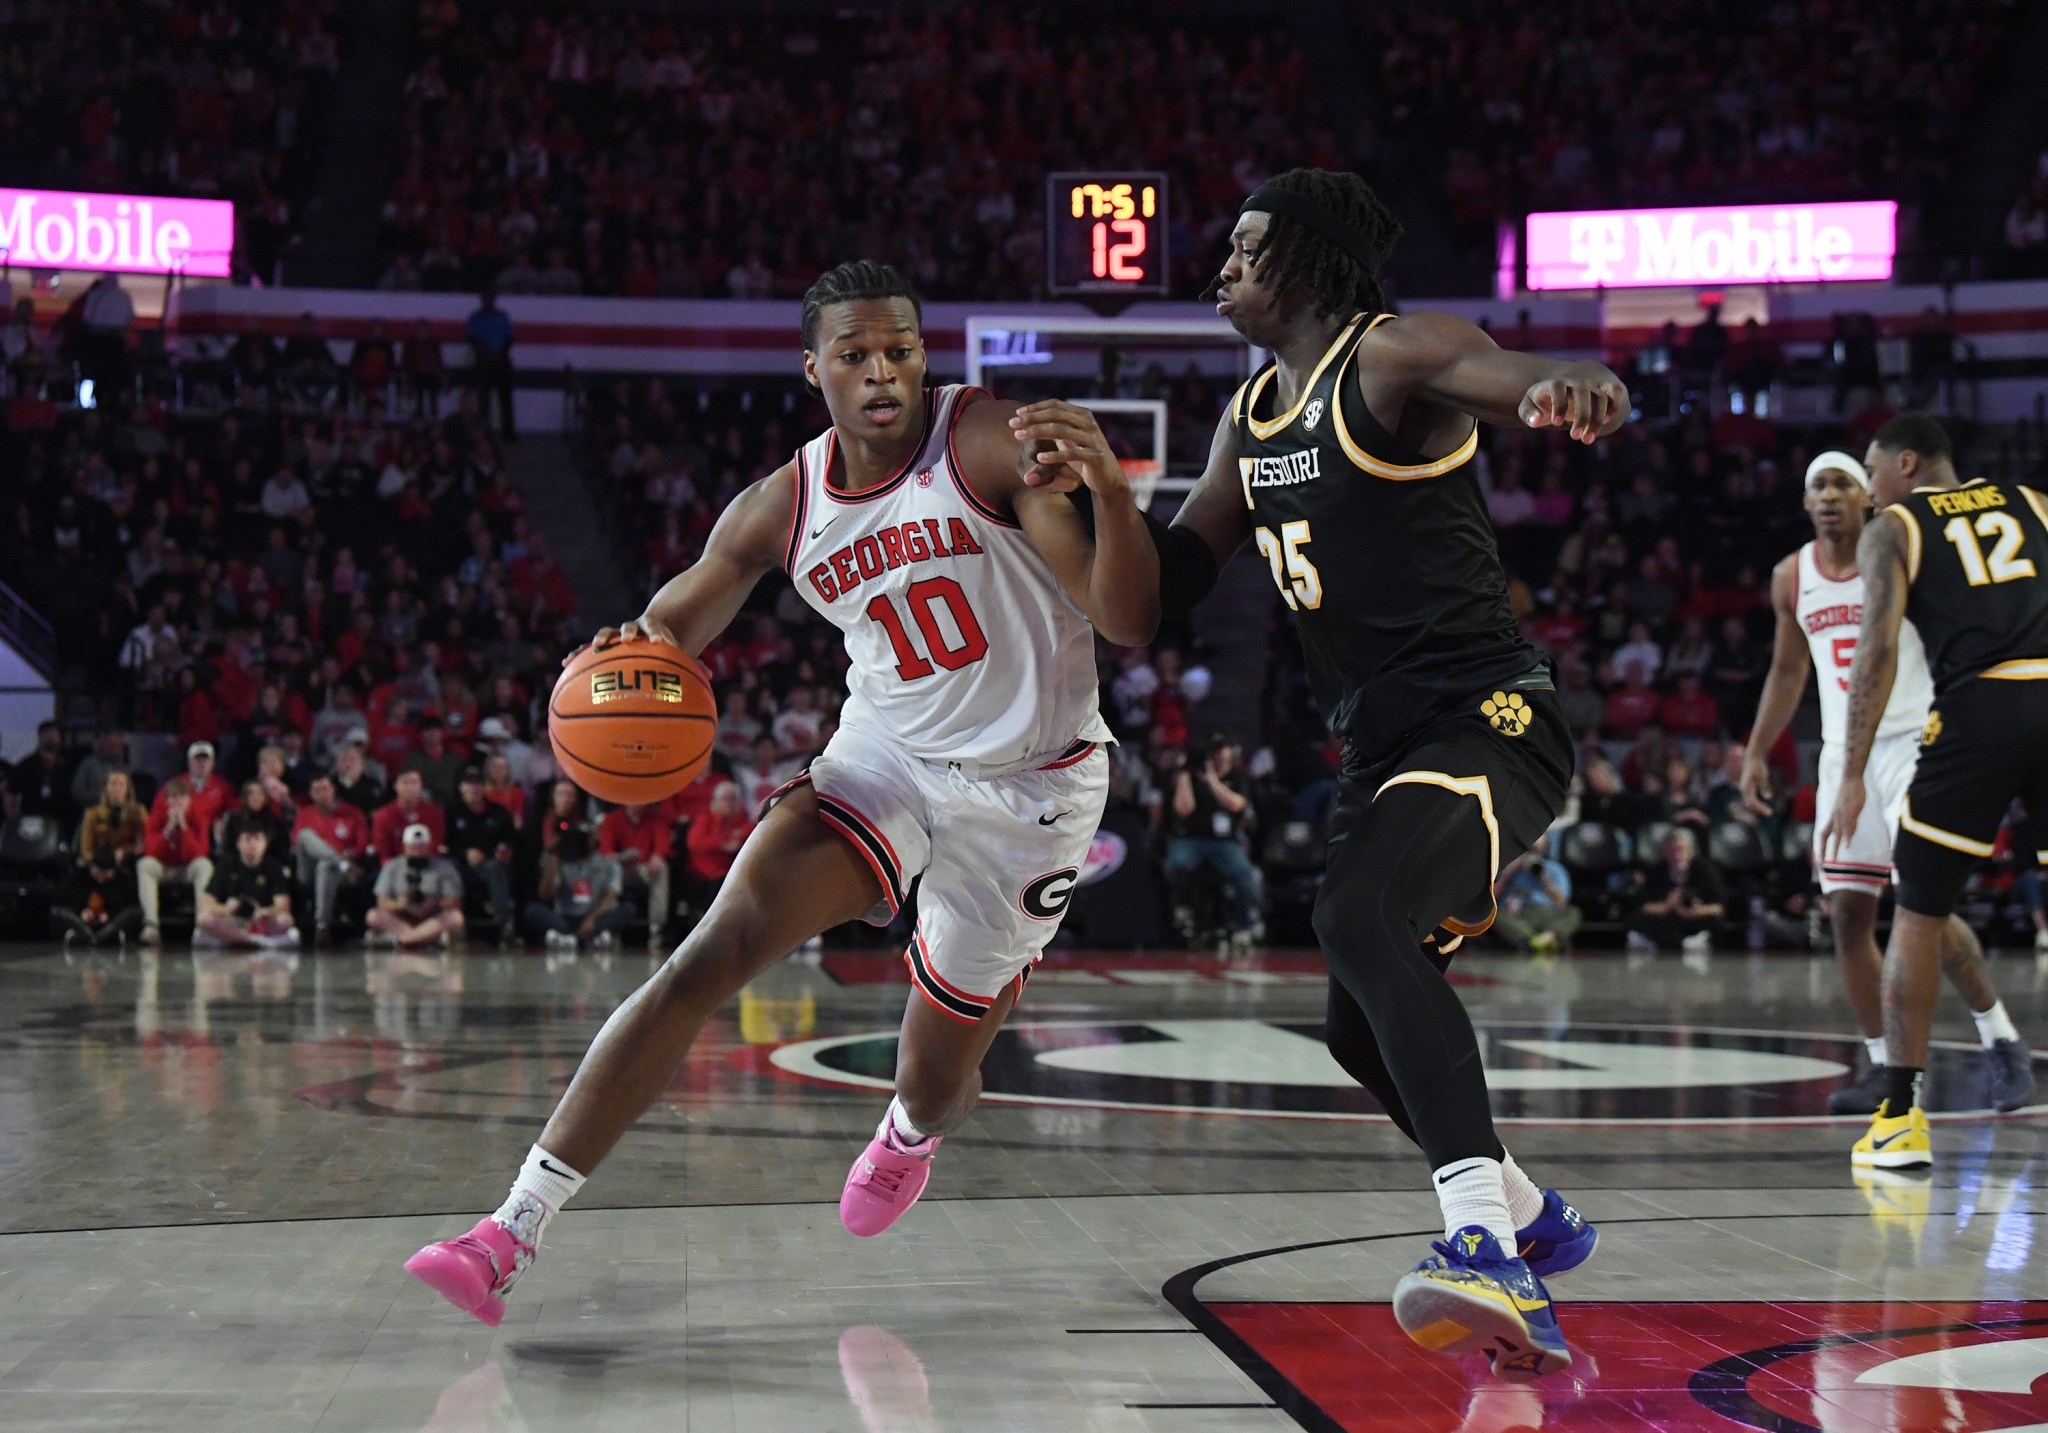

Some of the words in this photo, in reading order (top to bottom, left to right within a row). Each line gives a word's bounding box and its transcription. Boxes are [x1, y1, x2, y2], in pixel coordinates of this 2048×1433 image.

[1071, 184, 1155, 219] 17:51
[1092, 219, 1145, 280] 12
[1633, 210, 1853, 279] Mobile
[1302, 399, 1323, 430] SEC
[917, 468, 933, 487] SEC
[1927, 485, 2007, 516] PERKINS
[808, 517, 984, 604] GEORGIA
[1255, 519, 1323, 611] 25
[1943, 511, 2037, 587] 12
[866, 576, 989, 681] 10
[1496, 715, 1518, 732] M
[1020, 867, 1079, 920] G
